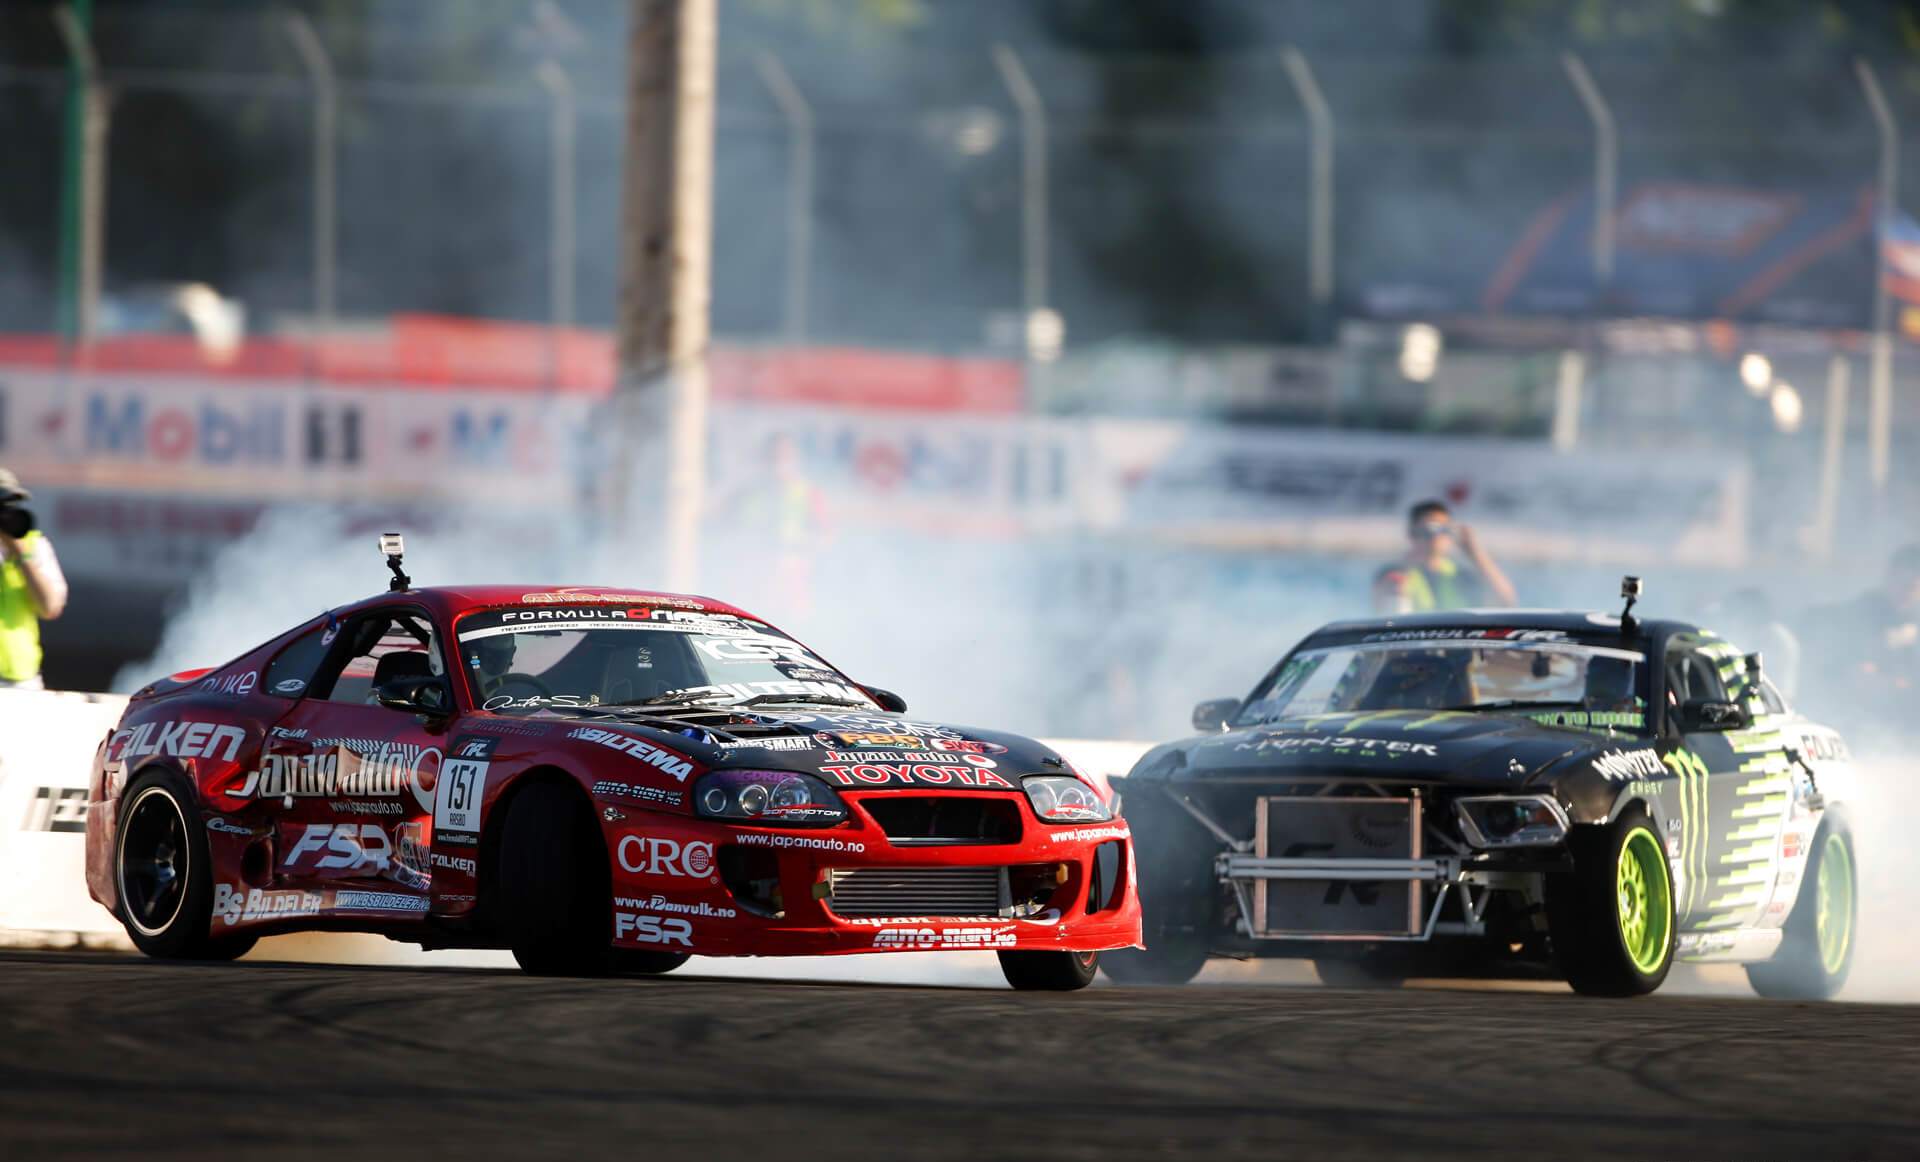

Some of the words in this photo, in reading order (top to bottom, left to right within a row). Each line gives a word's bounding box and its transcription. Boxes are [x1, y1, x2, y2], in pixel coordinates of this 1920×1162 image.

[502, 610, 627, 622] FORMULA
[107, 721, 246, 763] FALKEN
[271, 726, 308, 738] TEAM
[576, 727, 693, 782] BILTEMA
[447, 764, 478, 811] 151
[820, 765, 1015, 788] TOYOTA
[284, 823, 393, 869] FSR
[617, 835, 715, 878] CRC
[736, 833, 865, 852] www.japanauto.no
[430, 853, 476, 873] FALKEN
[615, 912, 695, 947] FSR
